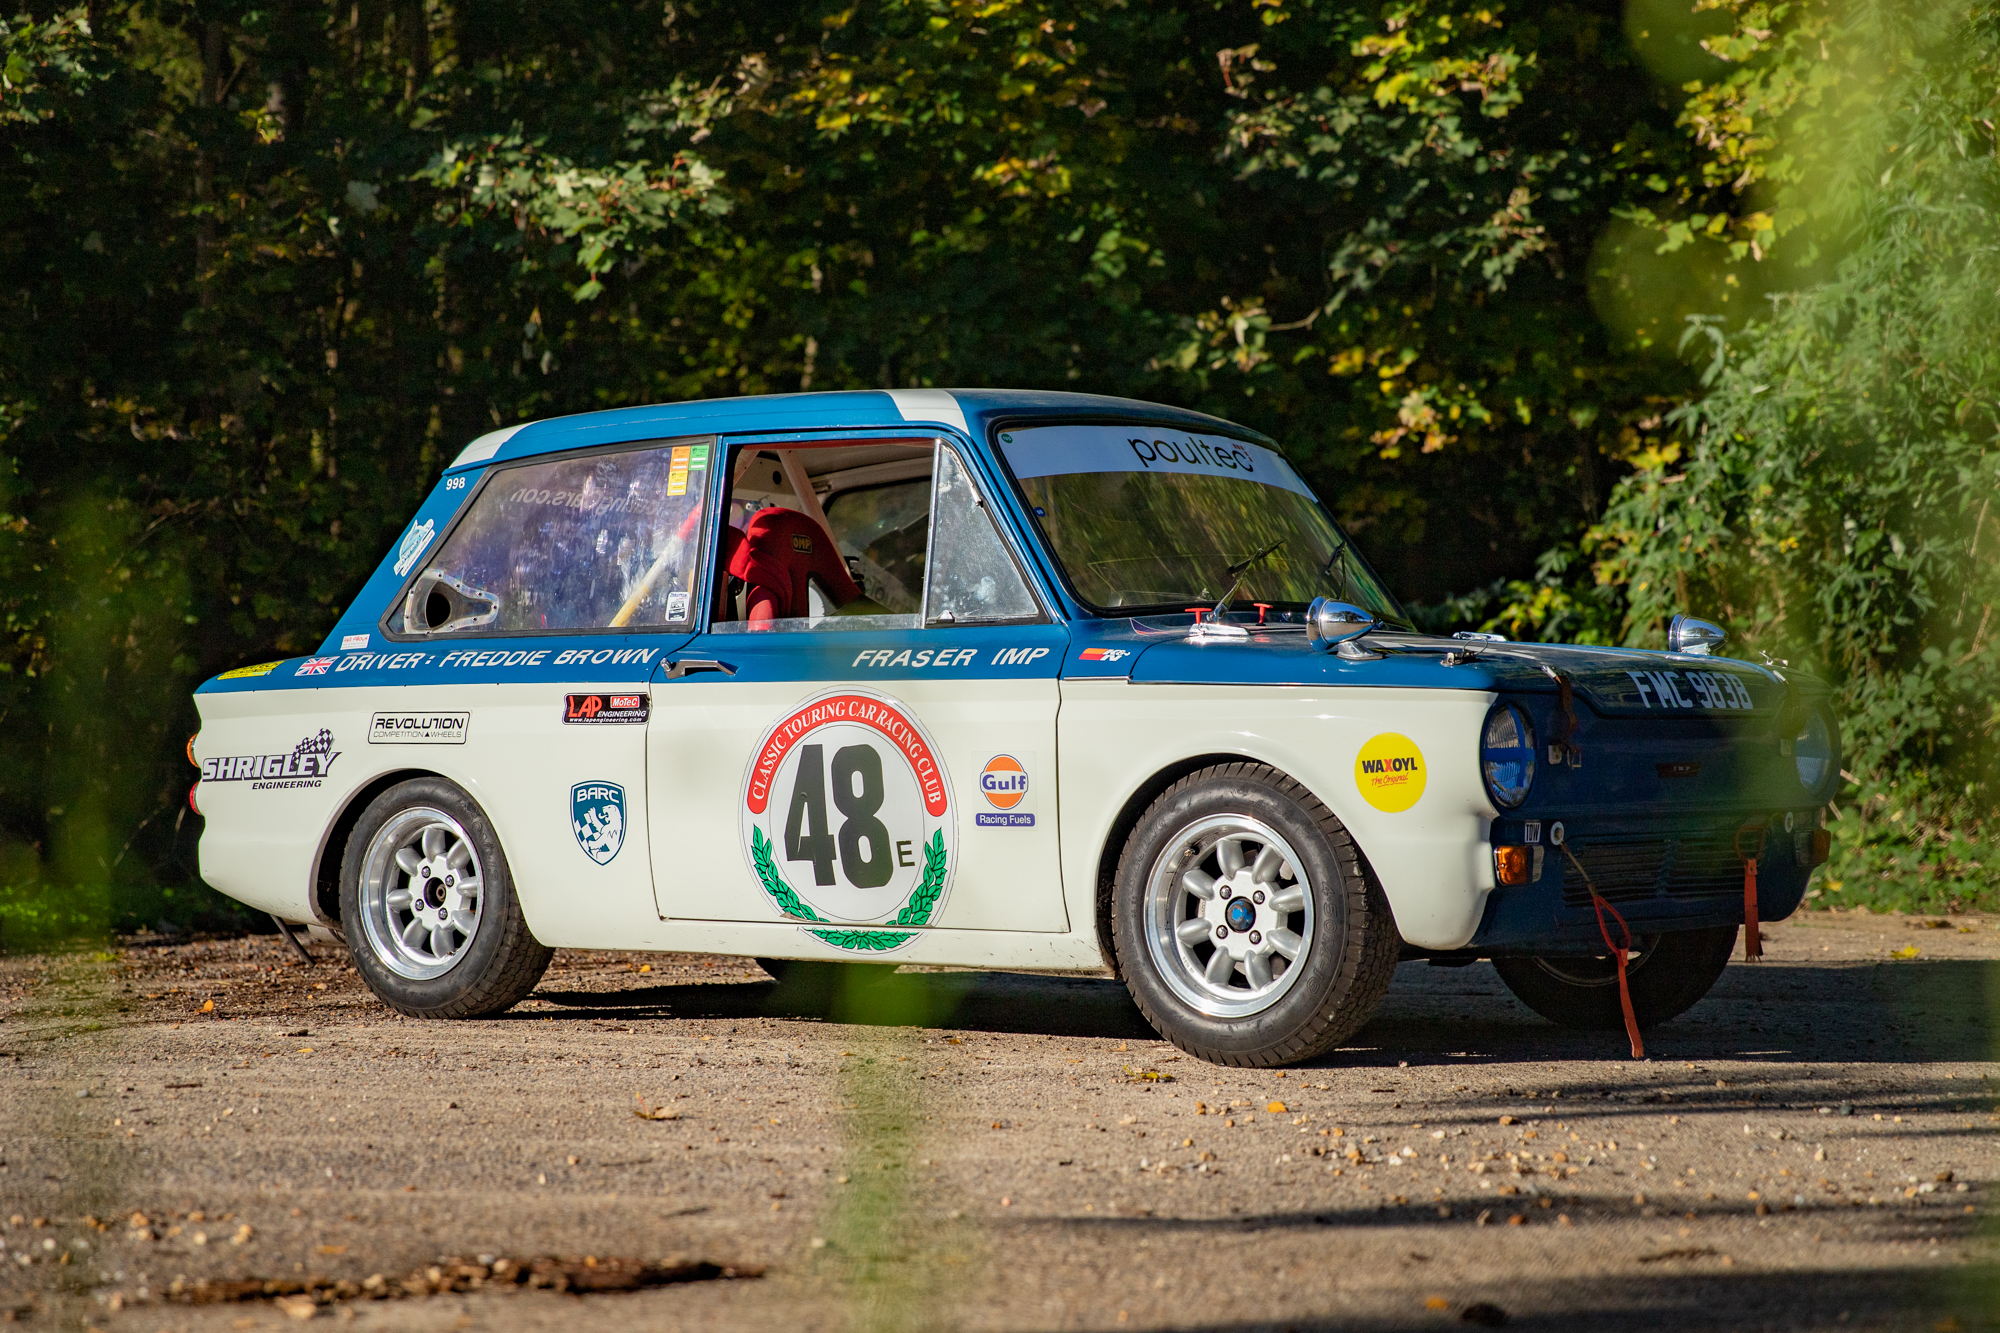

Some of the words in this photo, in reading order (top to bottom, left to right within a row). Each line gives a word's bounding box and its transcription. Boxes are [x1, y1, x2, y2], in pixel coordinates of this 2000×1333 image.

[1126, 436, 1254, 473] poultec
[446, 476, 466, 491] 998
[792, 535, 812, 551] OMP
[439, 650, 552, 668] FREDDIE
[553, 648, 660, 665] BROWN
[851, 648, 978, 668] FRASER
[990, 647, 1050, 667] IMP
[1626, 671, 1694, 708] FMC
[1684, 671, 1754, 709] 983B
[568, 695, 603, 718] LAP
[612, 697, 638, 707] MoTeC
[596, 710, 647, 718] ENGINEERING
[374, 717, 465, 730] REVOLUTION
[373, 730, 425, 738] COMPETITION
[752, 734, 788, 800] CLASSIC
[782, 701, 846, 740] TOURING
[848, 701, 877, 722] CAR
[875, 709, 923, 759] RACING
[917, 757, 942, 804] CLUB
[202, 751, 343, 782] SHRIGLEY
[1361, 757, 1418, 774] WAXOYL
[251, 780, 323, 790] ENGINEERING
[982, 774, 1026, 790] Gulf
[1371, 776, 1383, 786] The
[576, 787, 620, 804] BARC
[784, 744, 894, 889] 48
[896, 840, 915, 868] E
[979, 814, 1008, 826] Racing
[1009, 814, 1032, 824] Fuels
[1525, 823, 1540, 842] TOW
